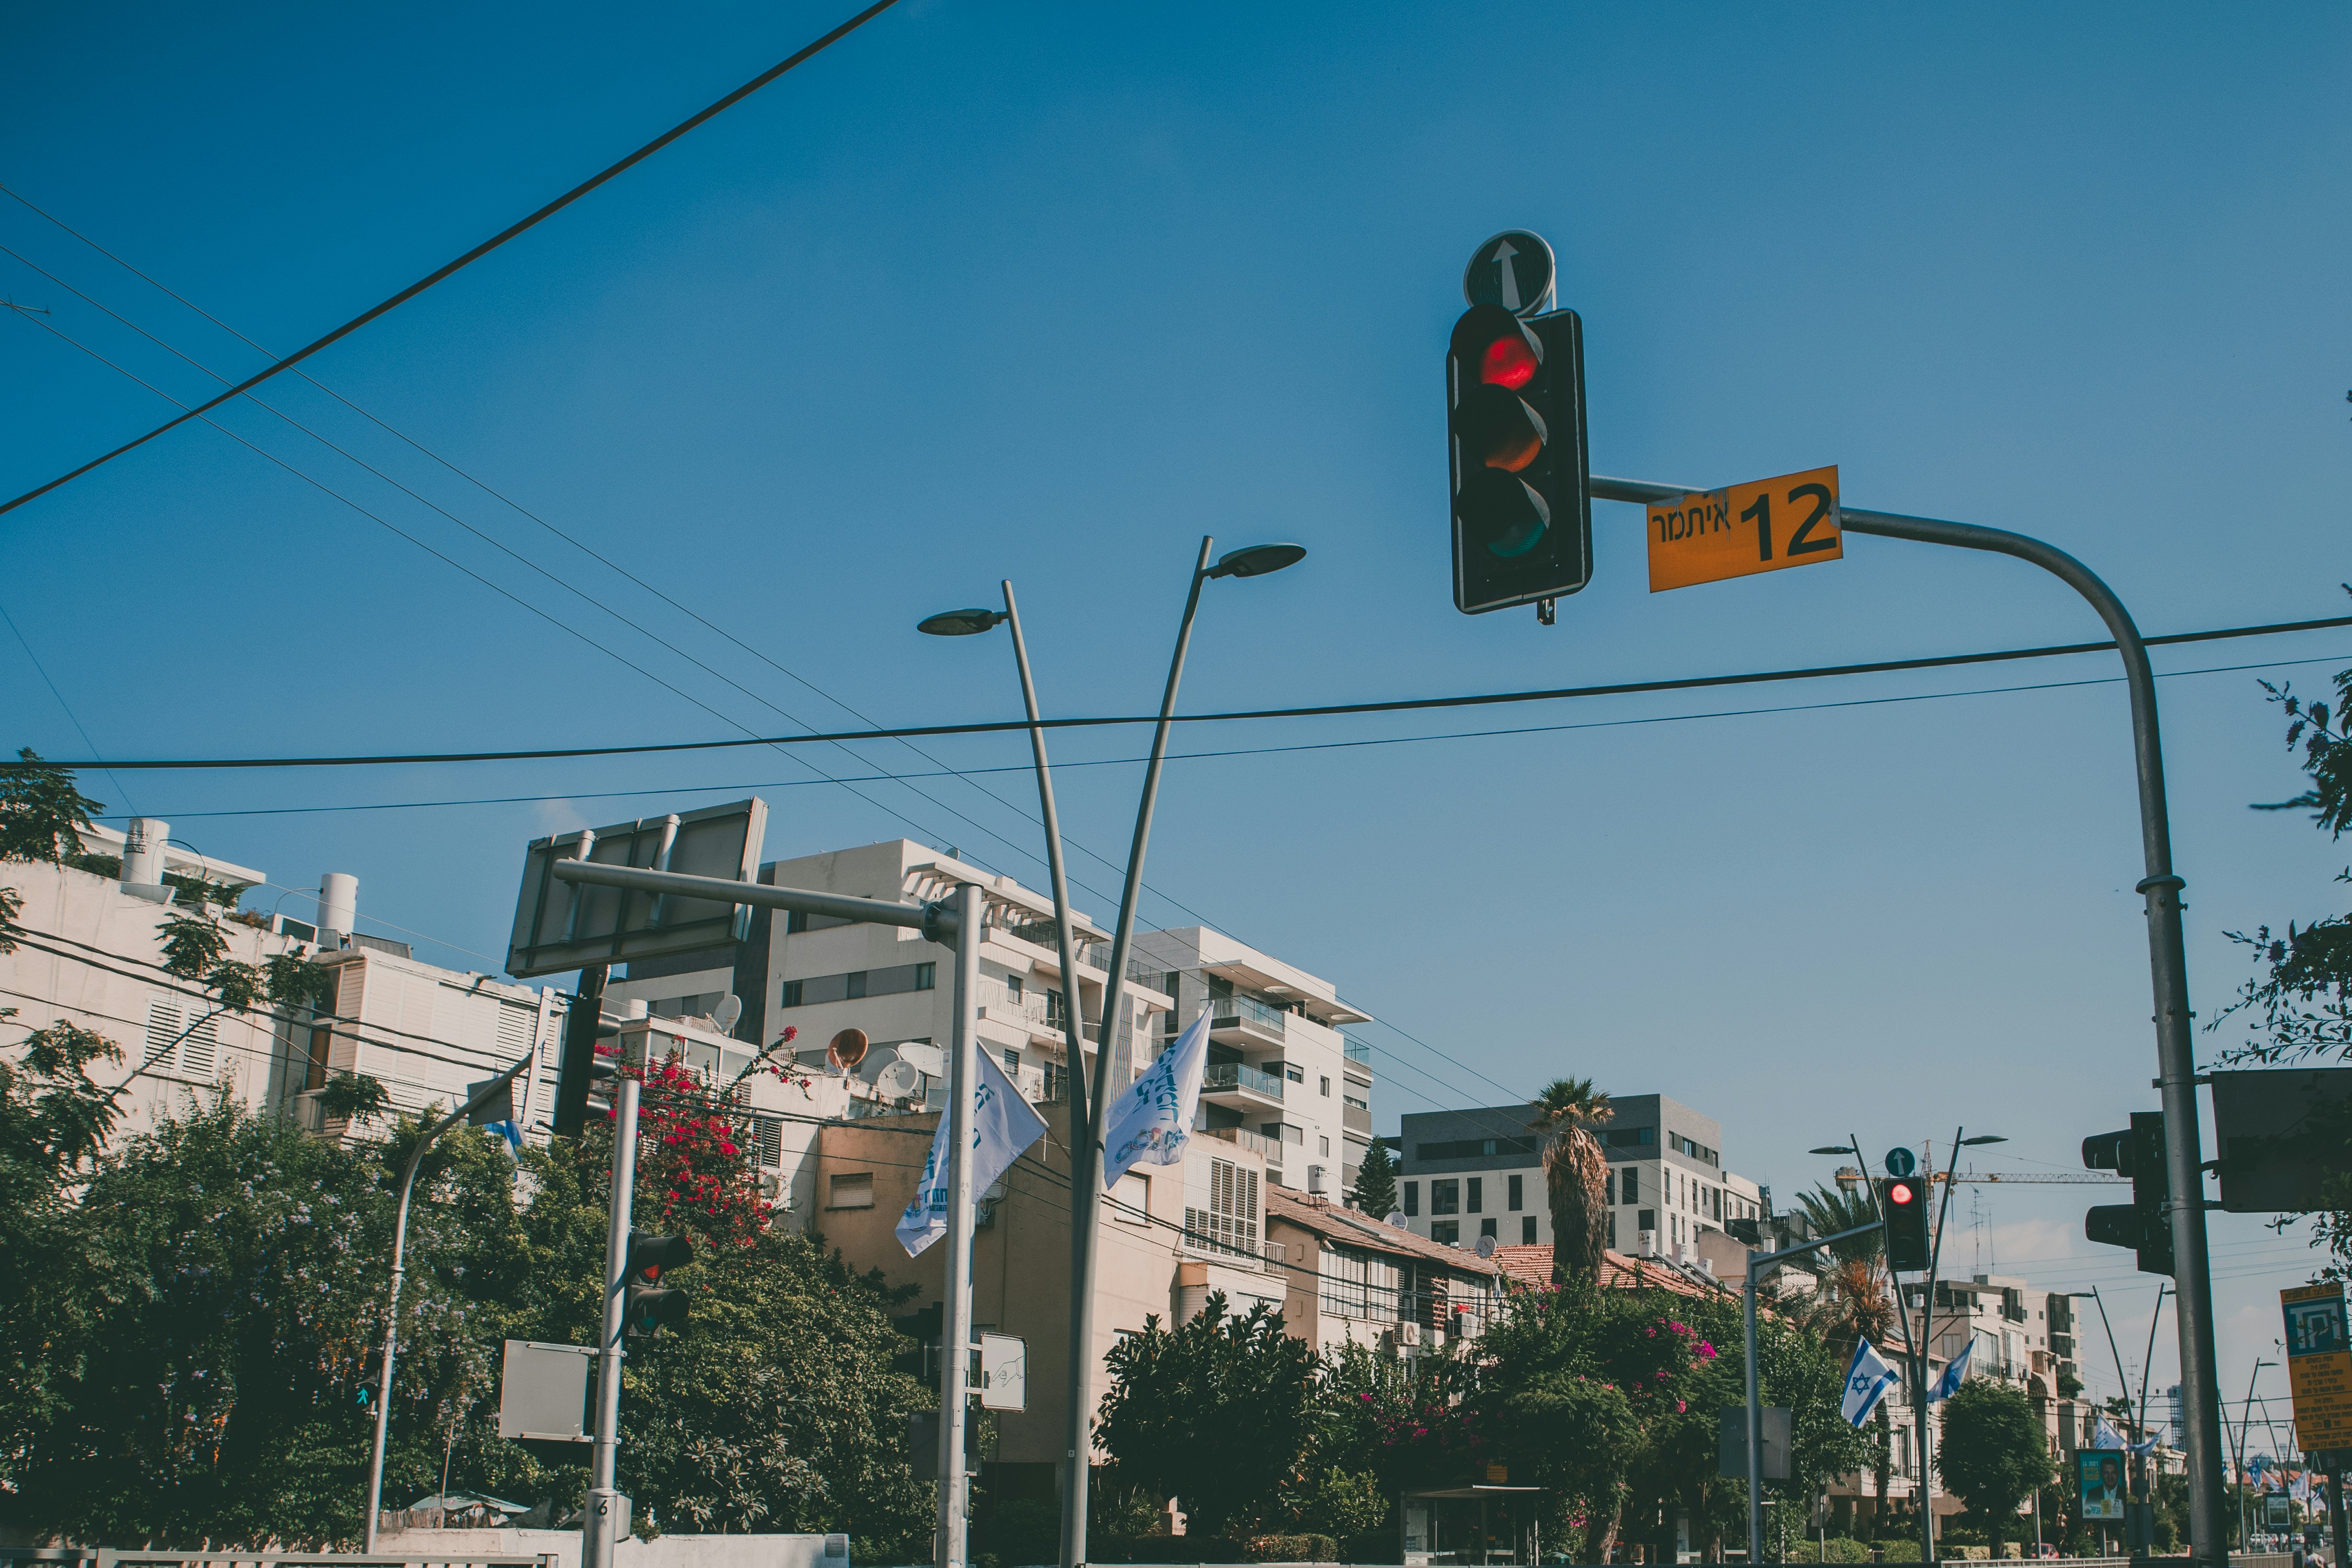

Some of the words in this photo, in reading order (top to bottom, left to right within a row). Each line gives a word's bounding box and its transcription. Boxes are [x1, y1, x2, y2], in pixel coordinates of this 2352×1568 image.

[1652, 503, 1731, 542] איתמר
[1741, 483, 1837, 561] 12
[597, 1500, 607, 1515] 6
